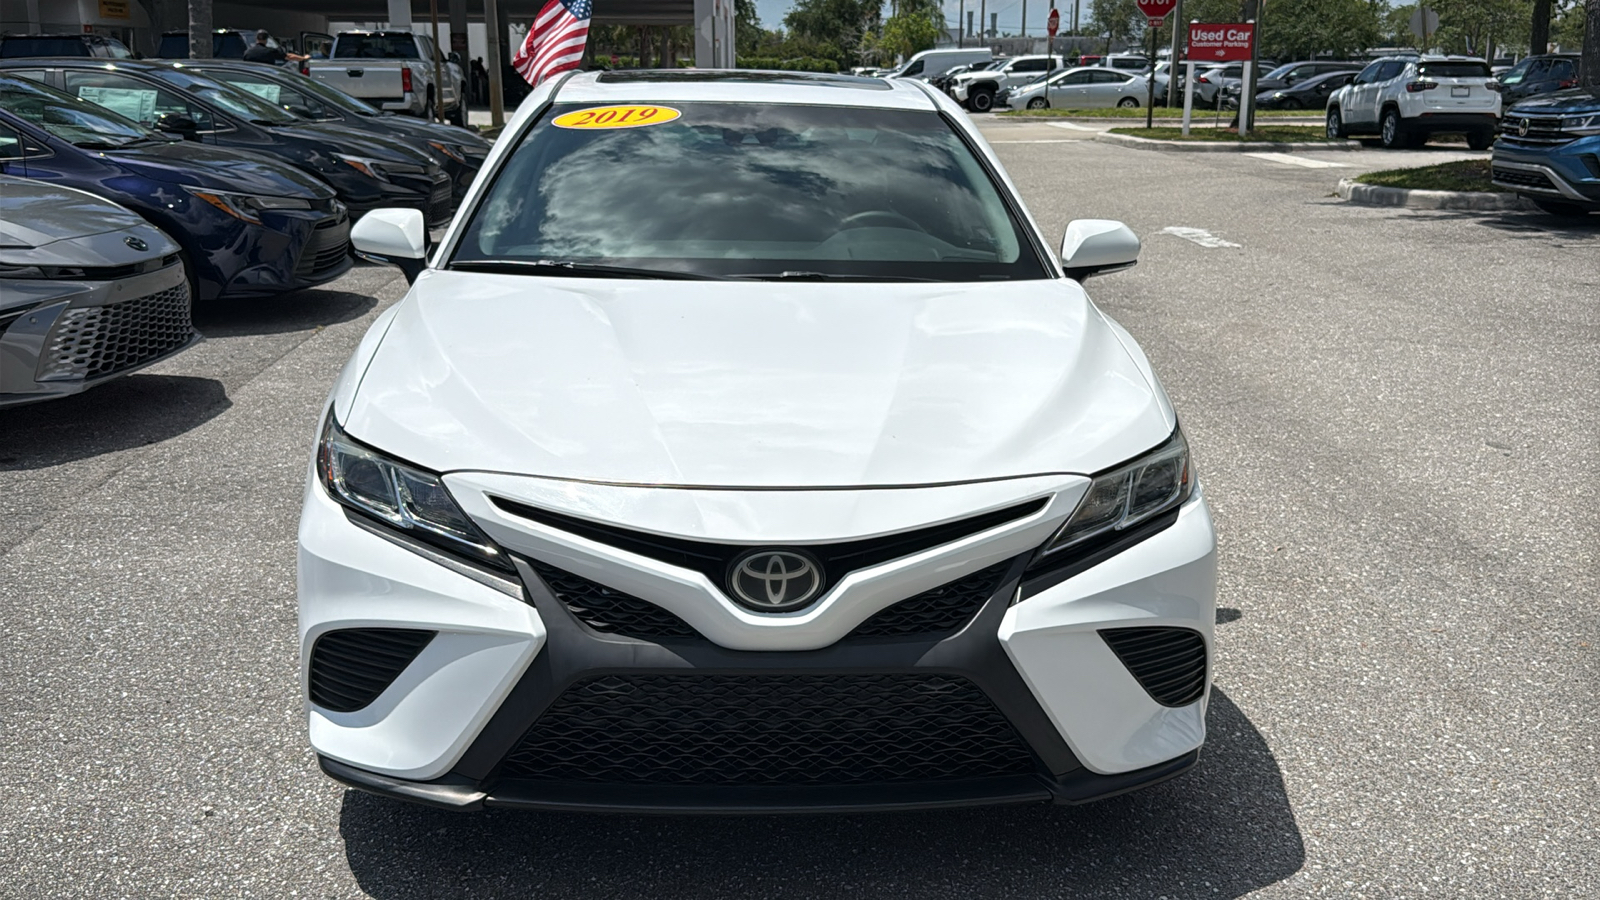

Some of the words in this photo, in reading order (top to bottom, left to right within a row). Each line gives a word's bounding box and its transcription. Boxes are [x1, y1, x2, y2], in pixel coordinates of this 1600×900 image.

[1191, 29, 1224, 41] Used
[1227, 29, 1250, 41] Car
[1224, 41, 1249, 49] Parking
[572, 108, 658, 126] 2019
